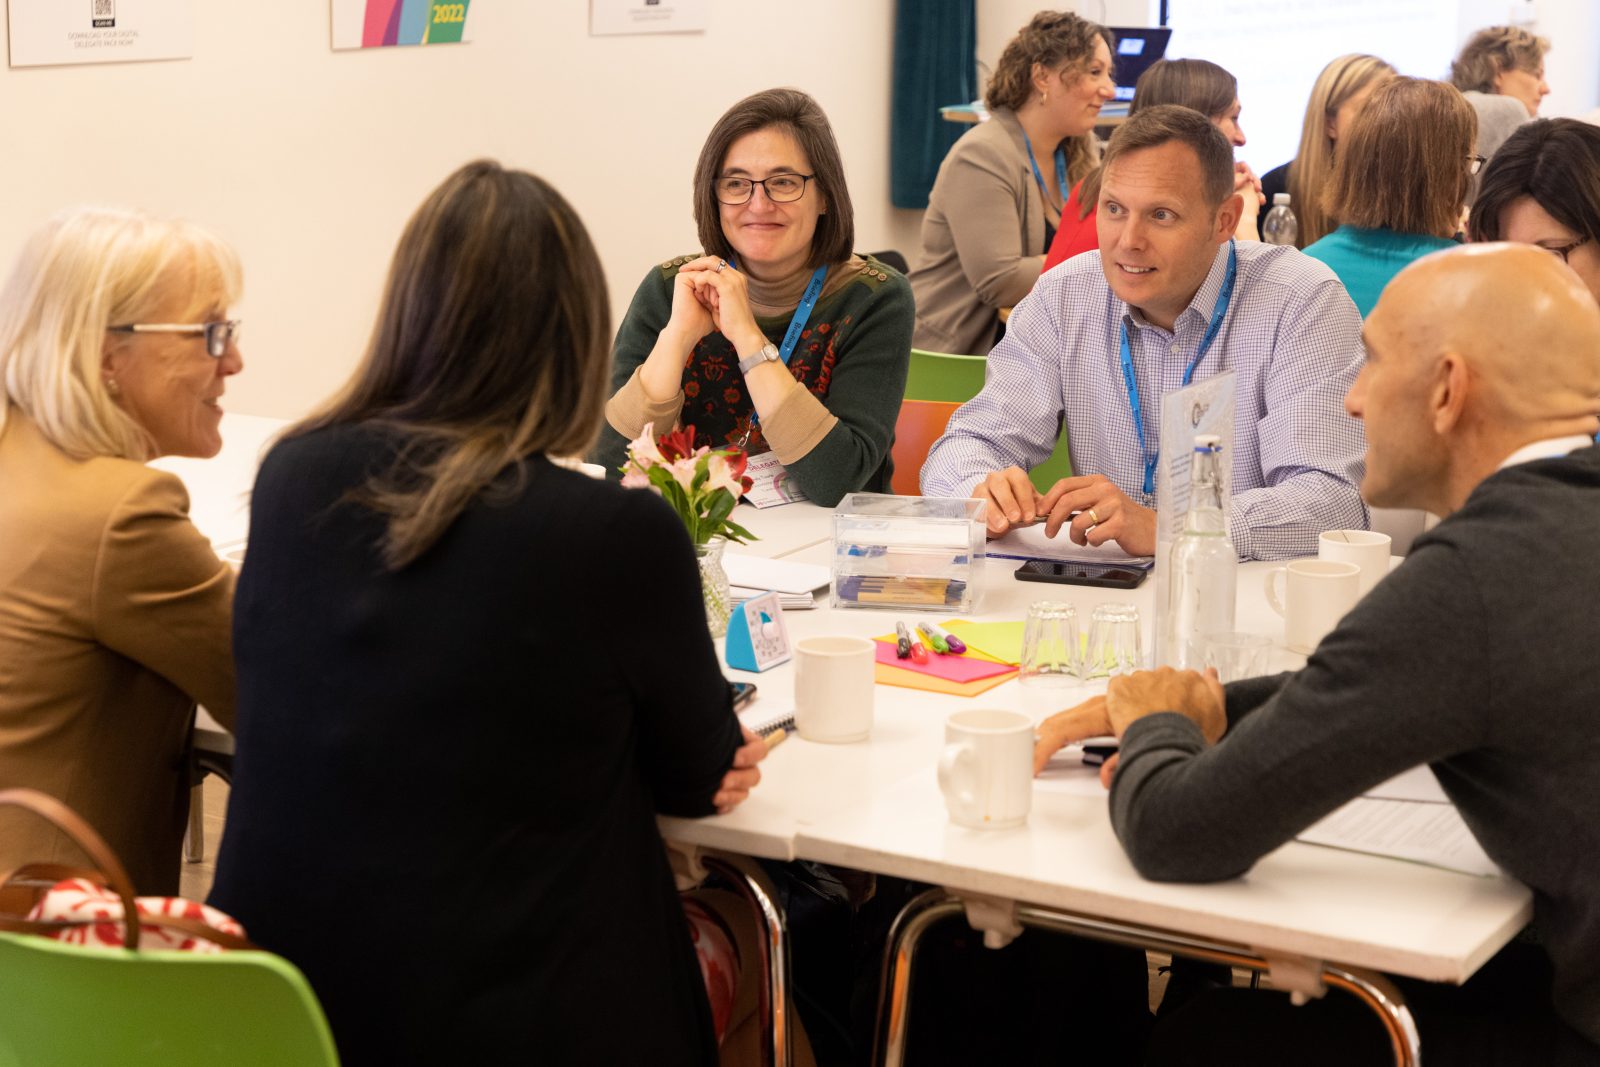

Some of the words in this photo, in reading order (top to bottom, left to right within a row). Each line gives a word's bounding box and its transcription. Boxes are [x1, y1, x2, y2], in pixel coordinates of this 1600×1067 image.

[433, 4, 464, 23] 2022
[803, 278, 821, 304] Briefing
[785, 322, 801, 348] Briefing
[1125, 363, 1134, 392] Briefing
